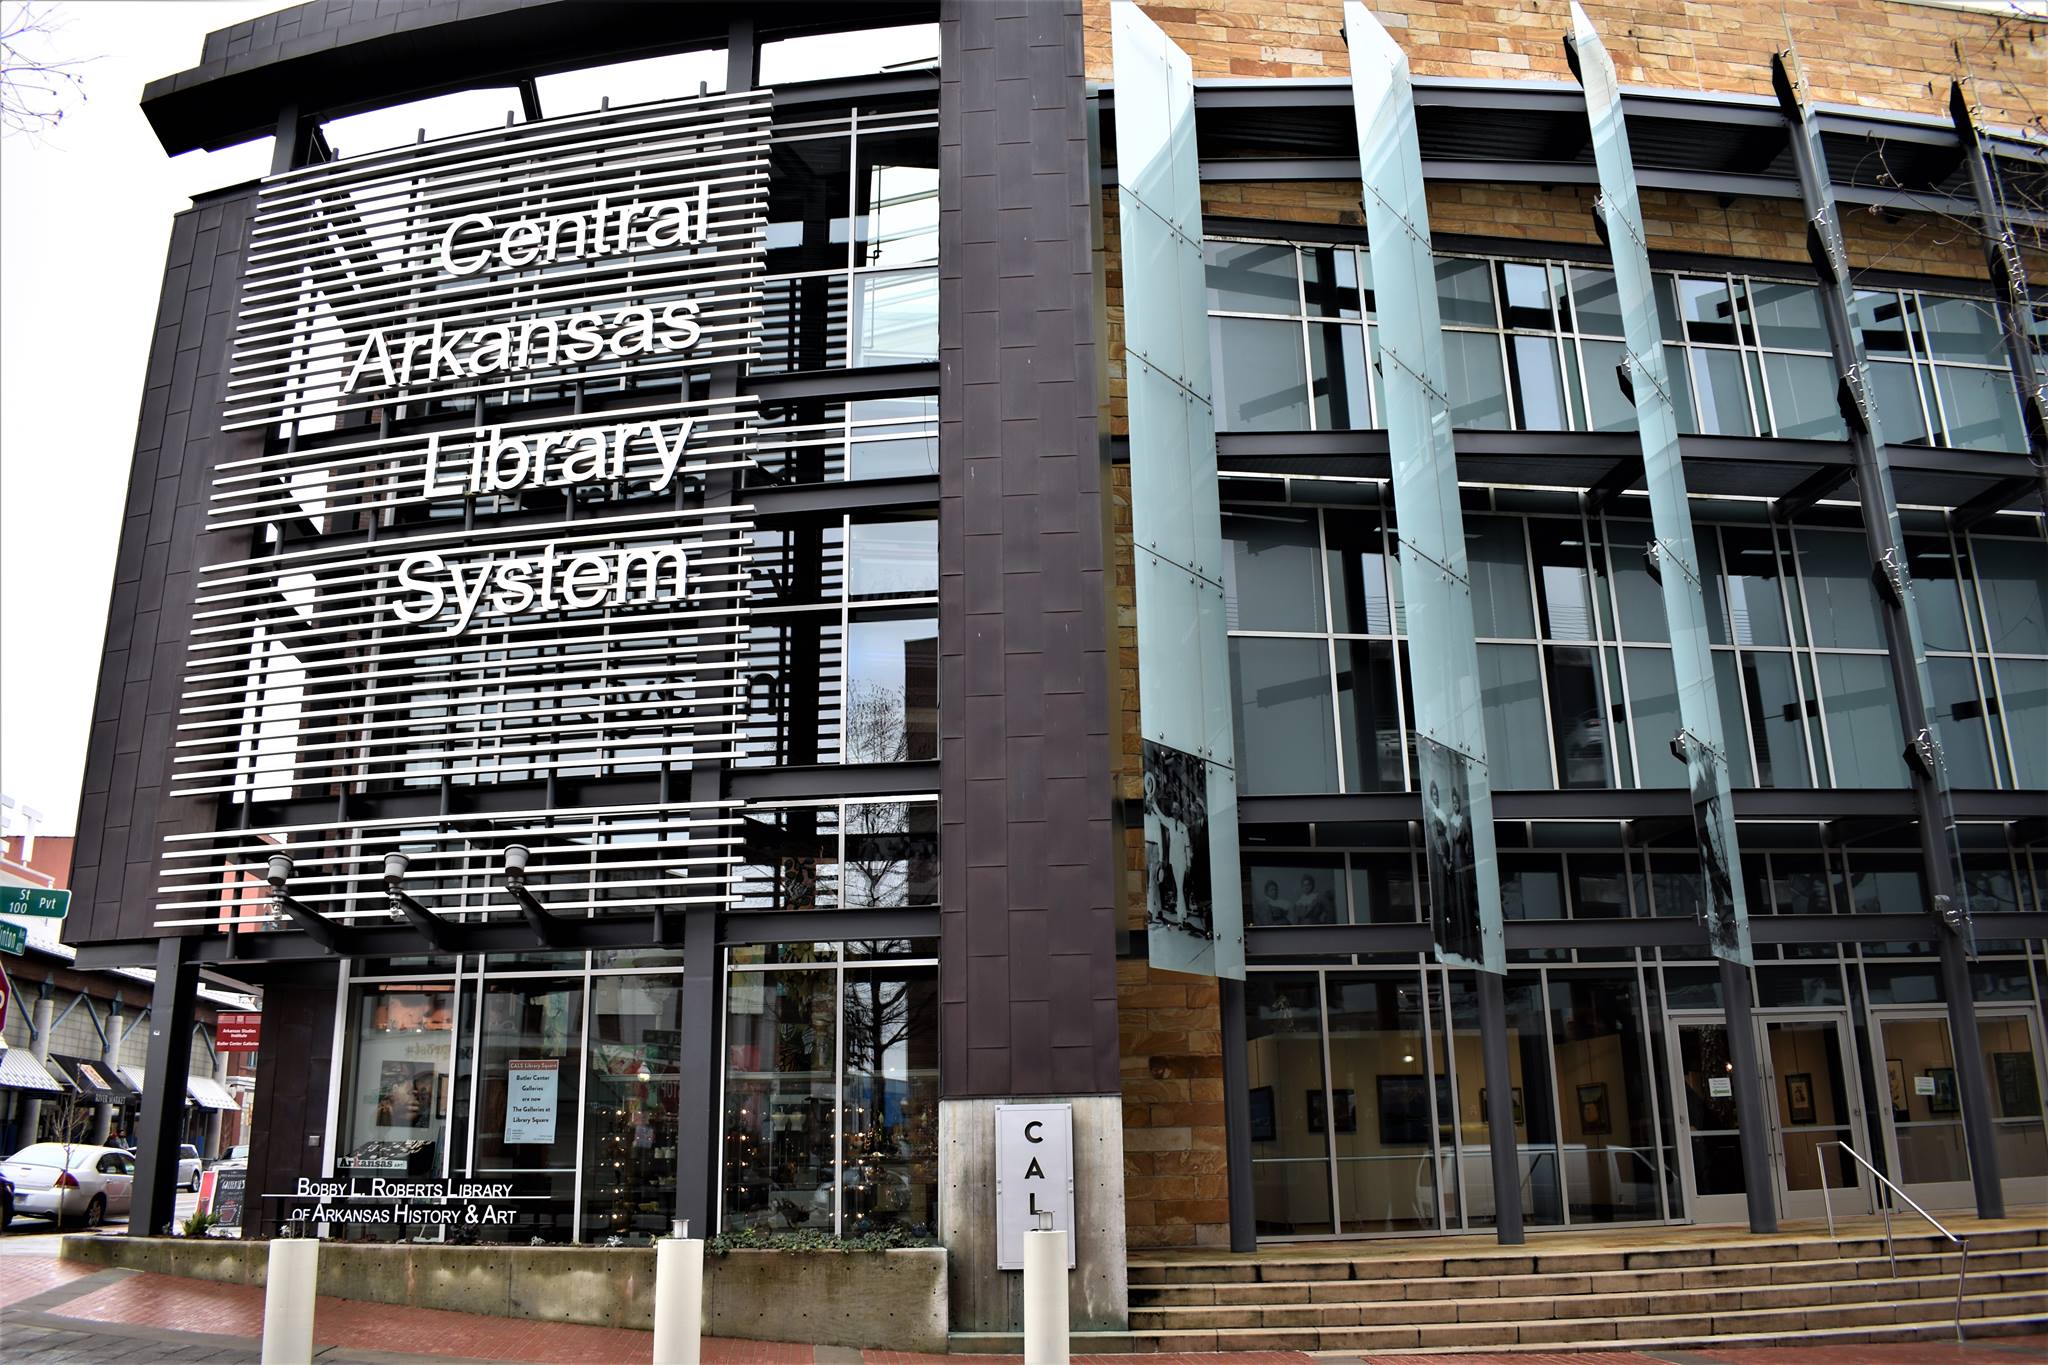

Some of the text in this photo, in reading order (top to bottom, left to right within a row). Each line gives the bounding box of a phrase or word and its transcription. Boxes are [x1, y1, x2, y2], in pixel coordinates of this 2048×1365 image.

[440, 181, 709, 276] Central
[343, 299, 701, 394] Arkansas
[423, 416, 695, 498] Library
[393, 544, 688, 637] System
[20, 889, 31, 900] St
[38, 897, 57, 910] Pvt
[9, 902, 28, 914] 100
[531, 1117, 549, 1125] Square
[340, 1151, 393, 1168] Arkansas
[1024, 1120, 1045, 1232] CAL
[297, 1177, 514, 1199] BOBBY L. ROBERTS LIBRARY
[312, 1203, 390, 1223] ARKANSAS
[394, 1203, 462, 1224] HISTORY
[465, 1204, 479, 1225] &
[481, 1204, 518, 1225] ART
